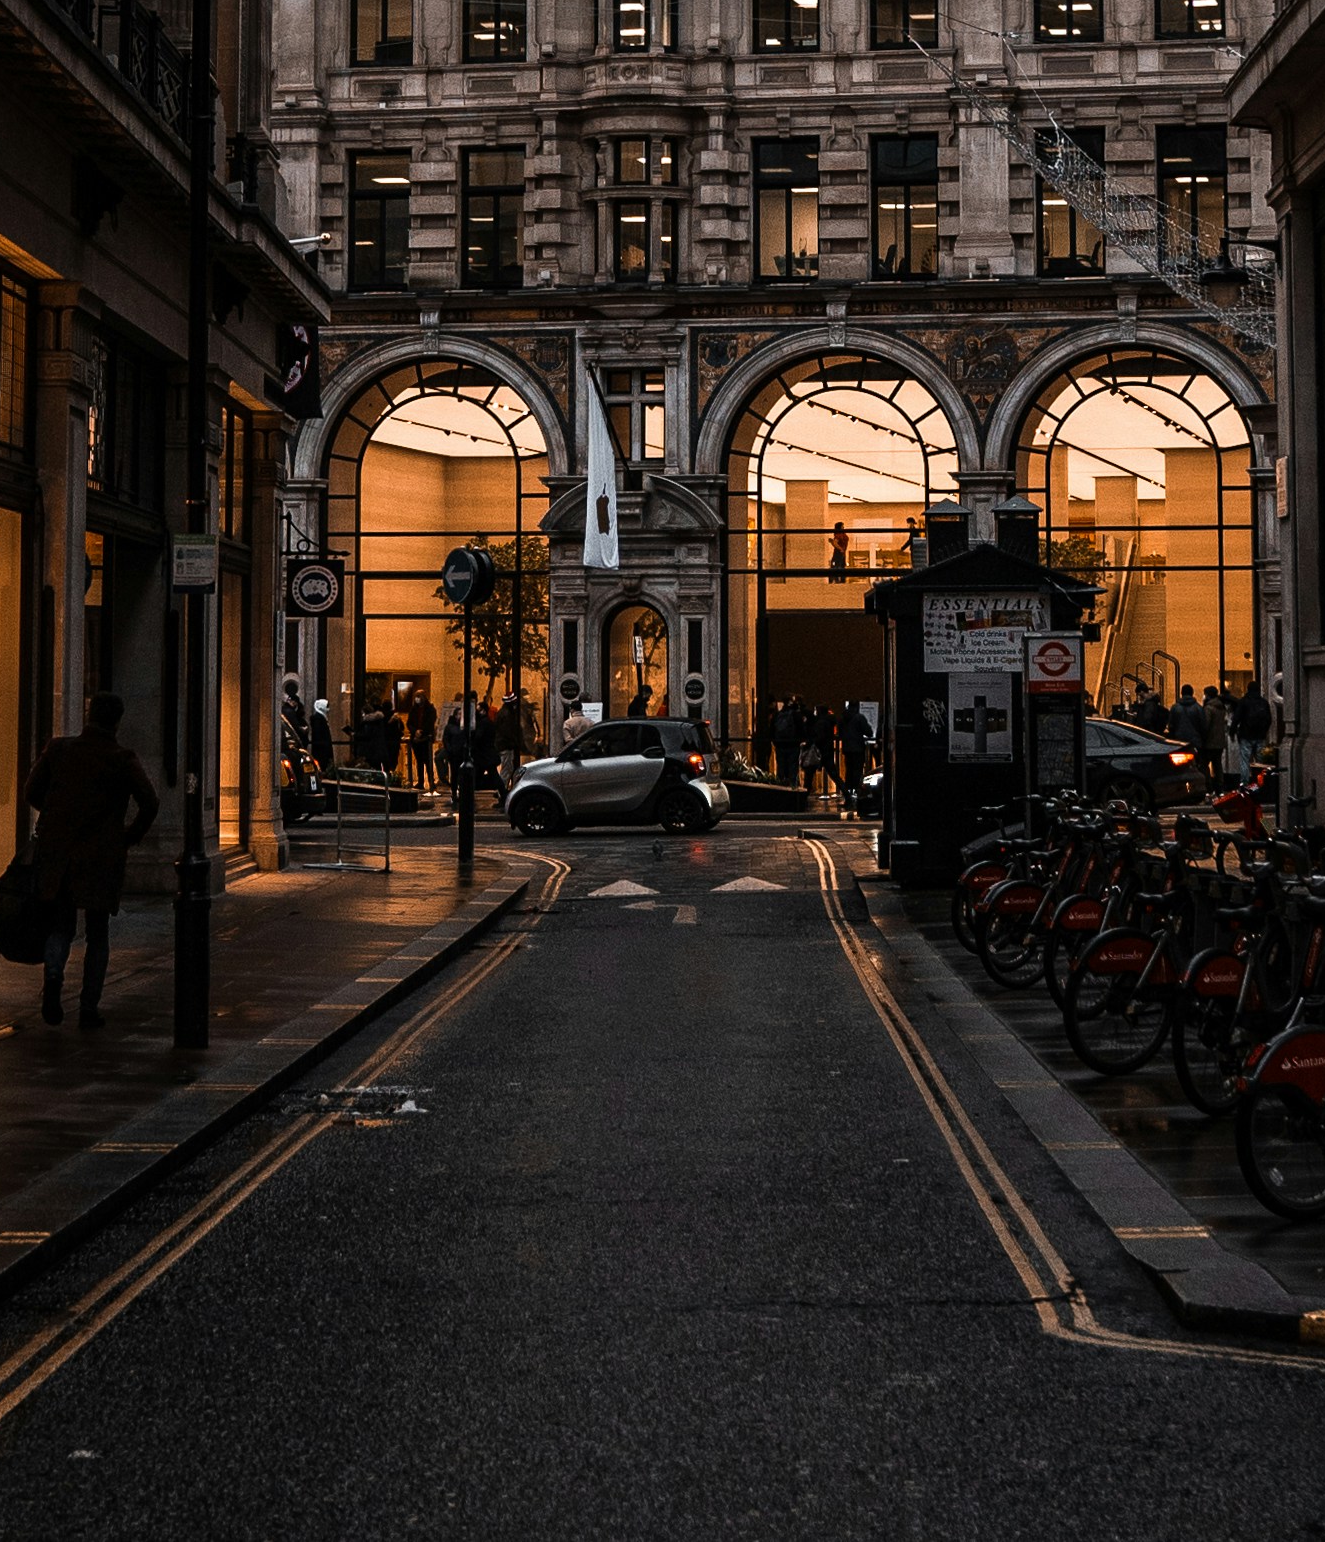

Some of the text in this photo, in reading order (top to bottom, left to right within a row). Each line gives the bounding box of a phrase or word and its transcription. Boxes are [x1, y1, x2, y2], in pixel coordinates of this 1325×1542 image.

[929, 598, 1046, 610] ESSENTIALS
[1108, 949, 1143, 960] Santander
[1209, 971, 1238, 983] Santander
